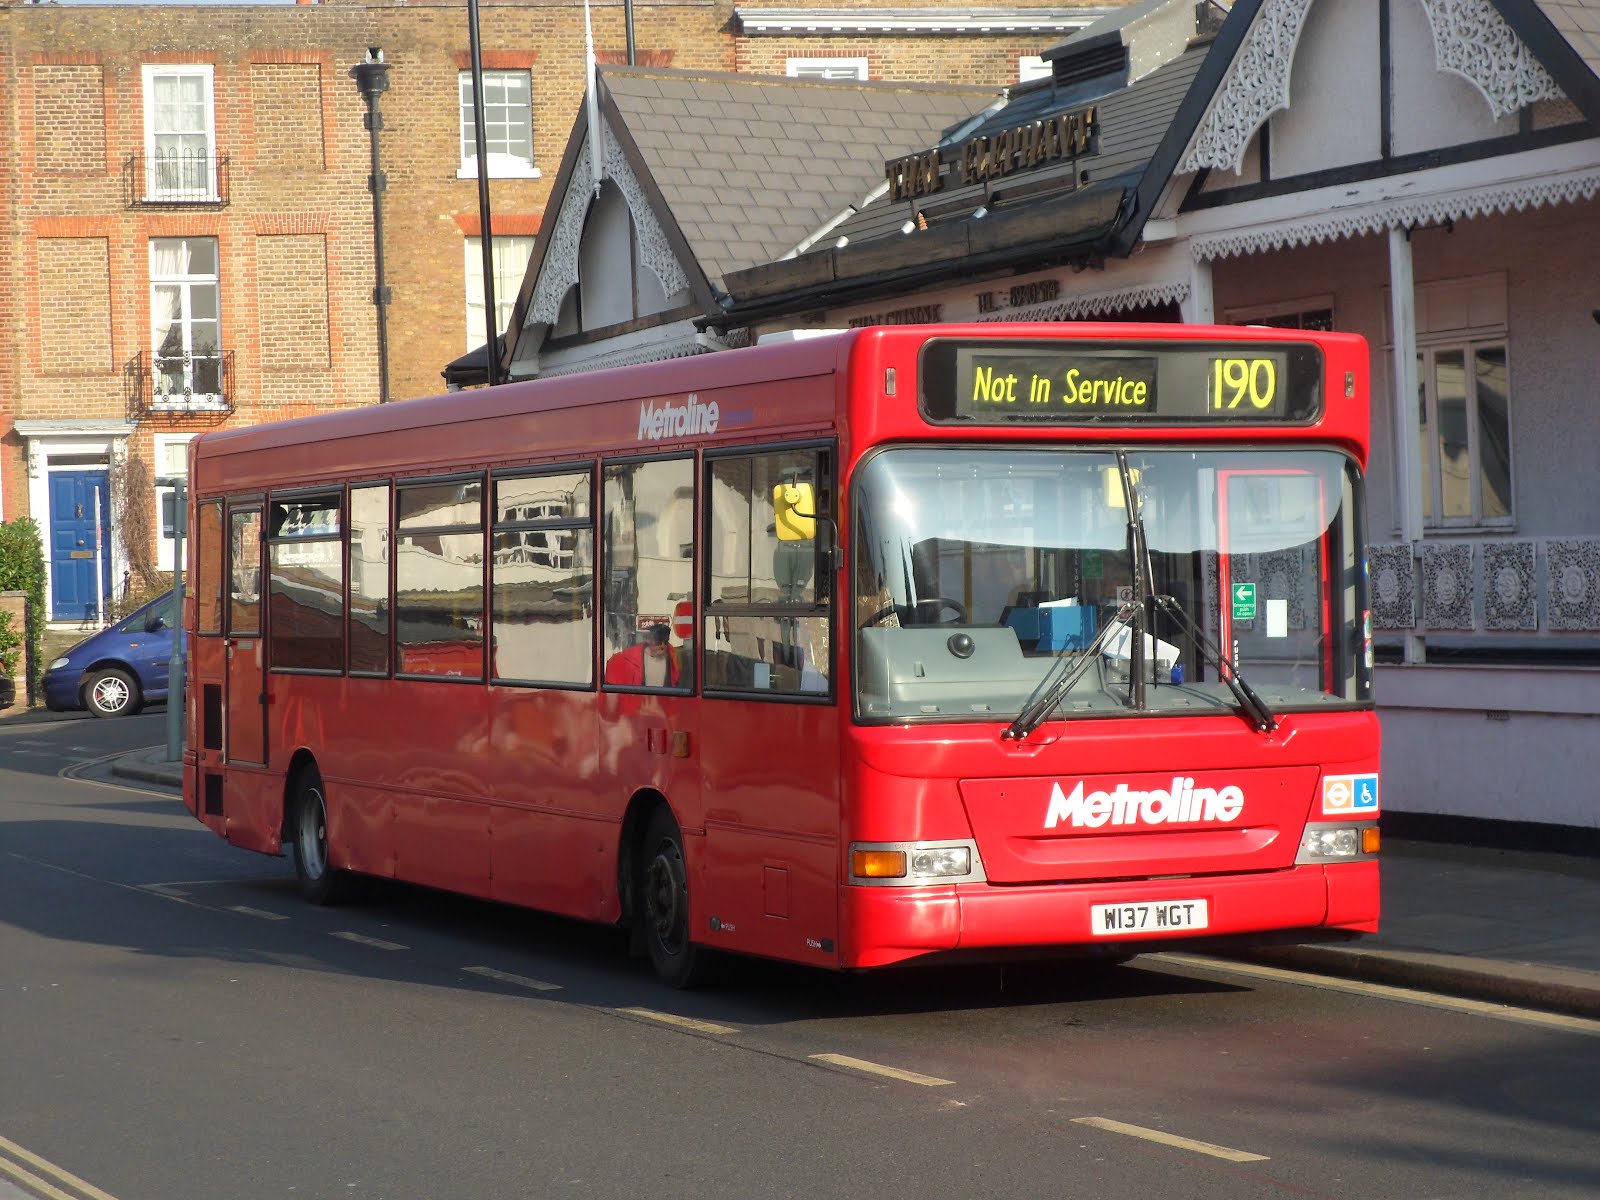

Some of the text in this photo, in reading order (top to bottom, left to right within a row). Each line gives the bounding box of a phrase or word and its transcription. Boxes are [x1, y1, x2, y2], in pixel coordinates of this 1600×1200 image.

[960, 106, 1097, 185] ELEPHANT
[973, 366, 1147, 405] Not in Service
[1213, 359, 1276, 409] 190
[638, 393, 720, 441] Metroline
[1044, 777, 1244, 828] Metroline
[1104, 903, 1195, 930] W137 WGT
